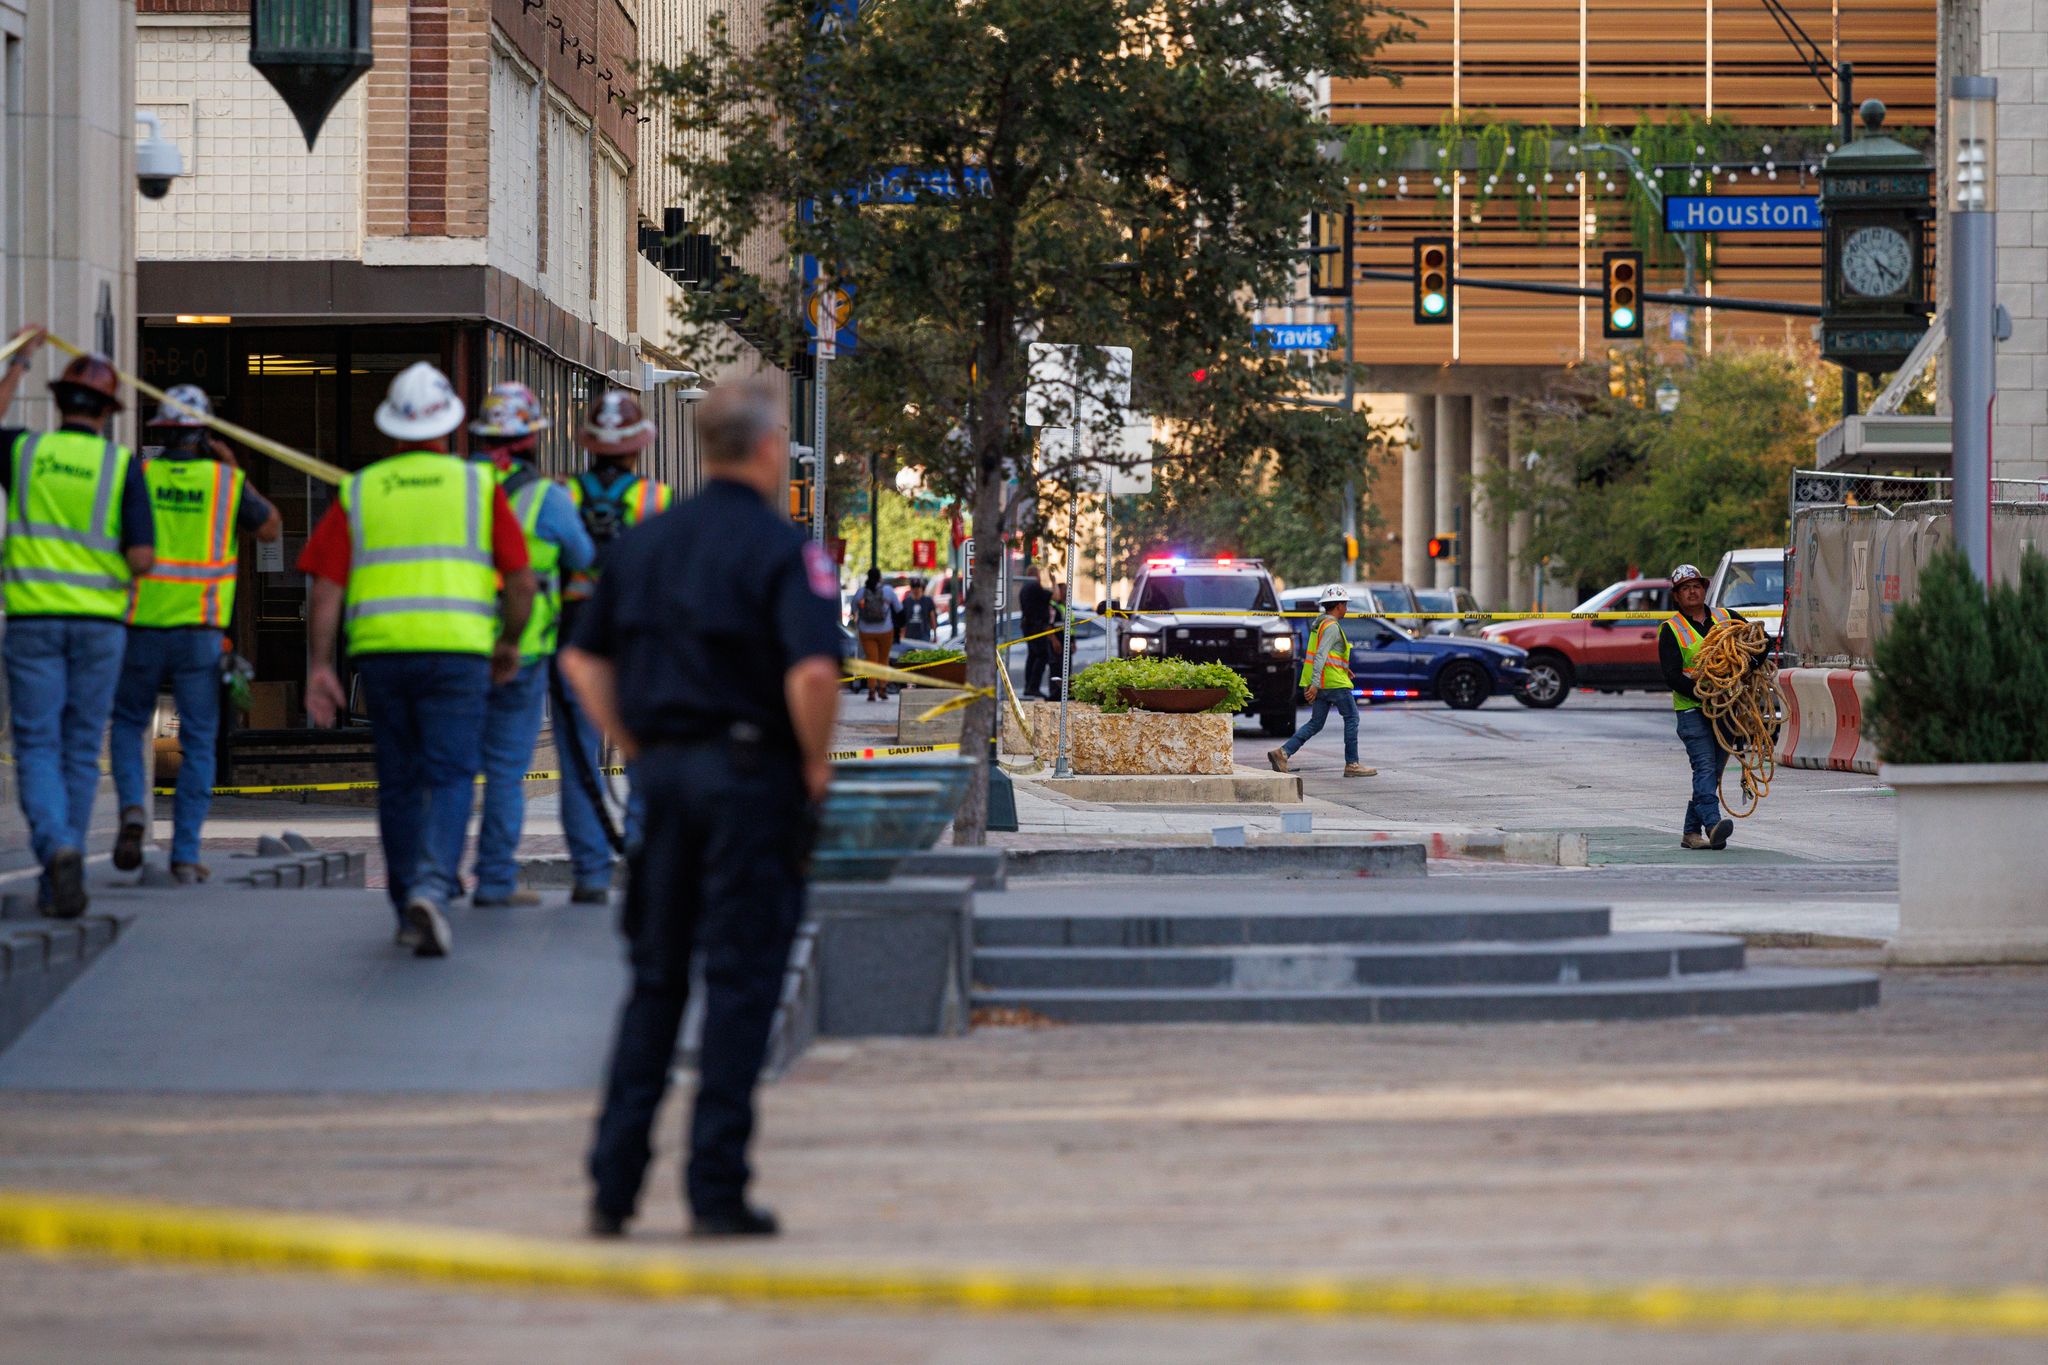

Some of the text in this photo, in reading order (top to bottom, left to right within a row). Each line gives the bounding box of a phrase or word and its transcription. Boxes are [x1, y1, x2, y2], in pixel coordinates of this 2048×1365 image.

[1688, 202, 1807, 225] Houston
[825, 745, 934, 761] UTION CAUTION
[601, 766, 625, 776] TION
